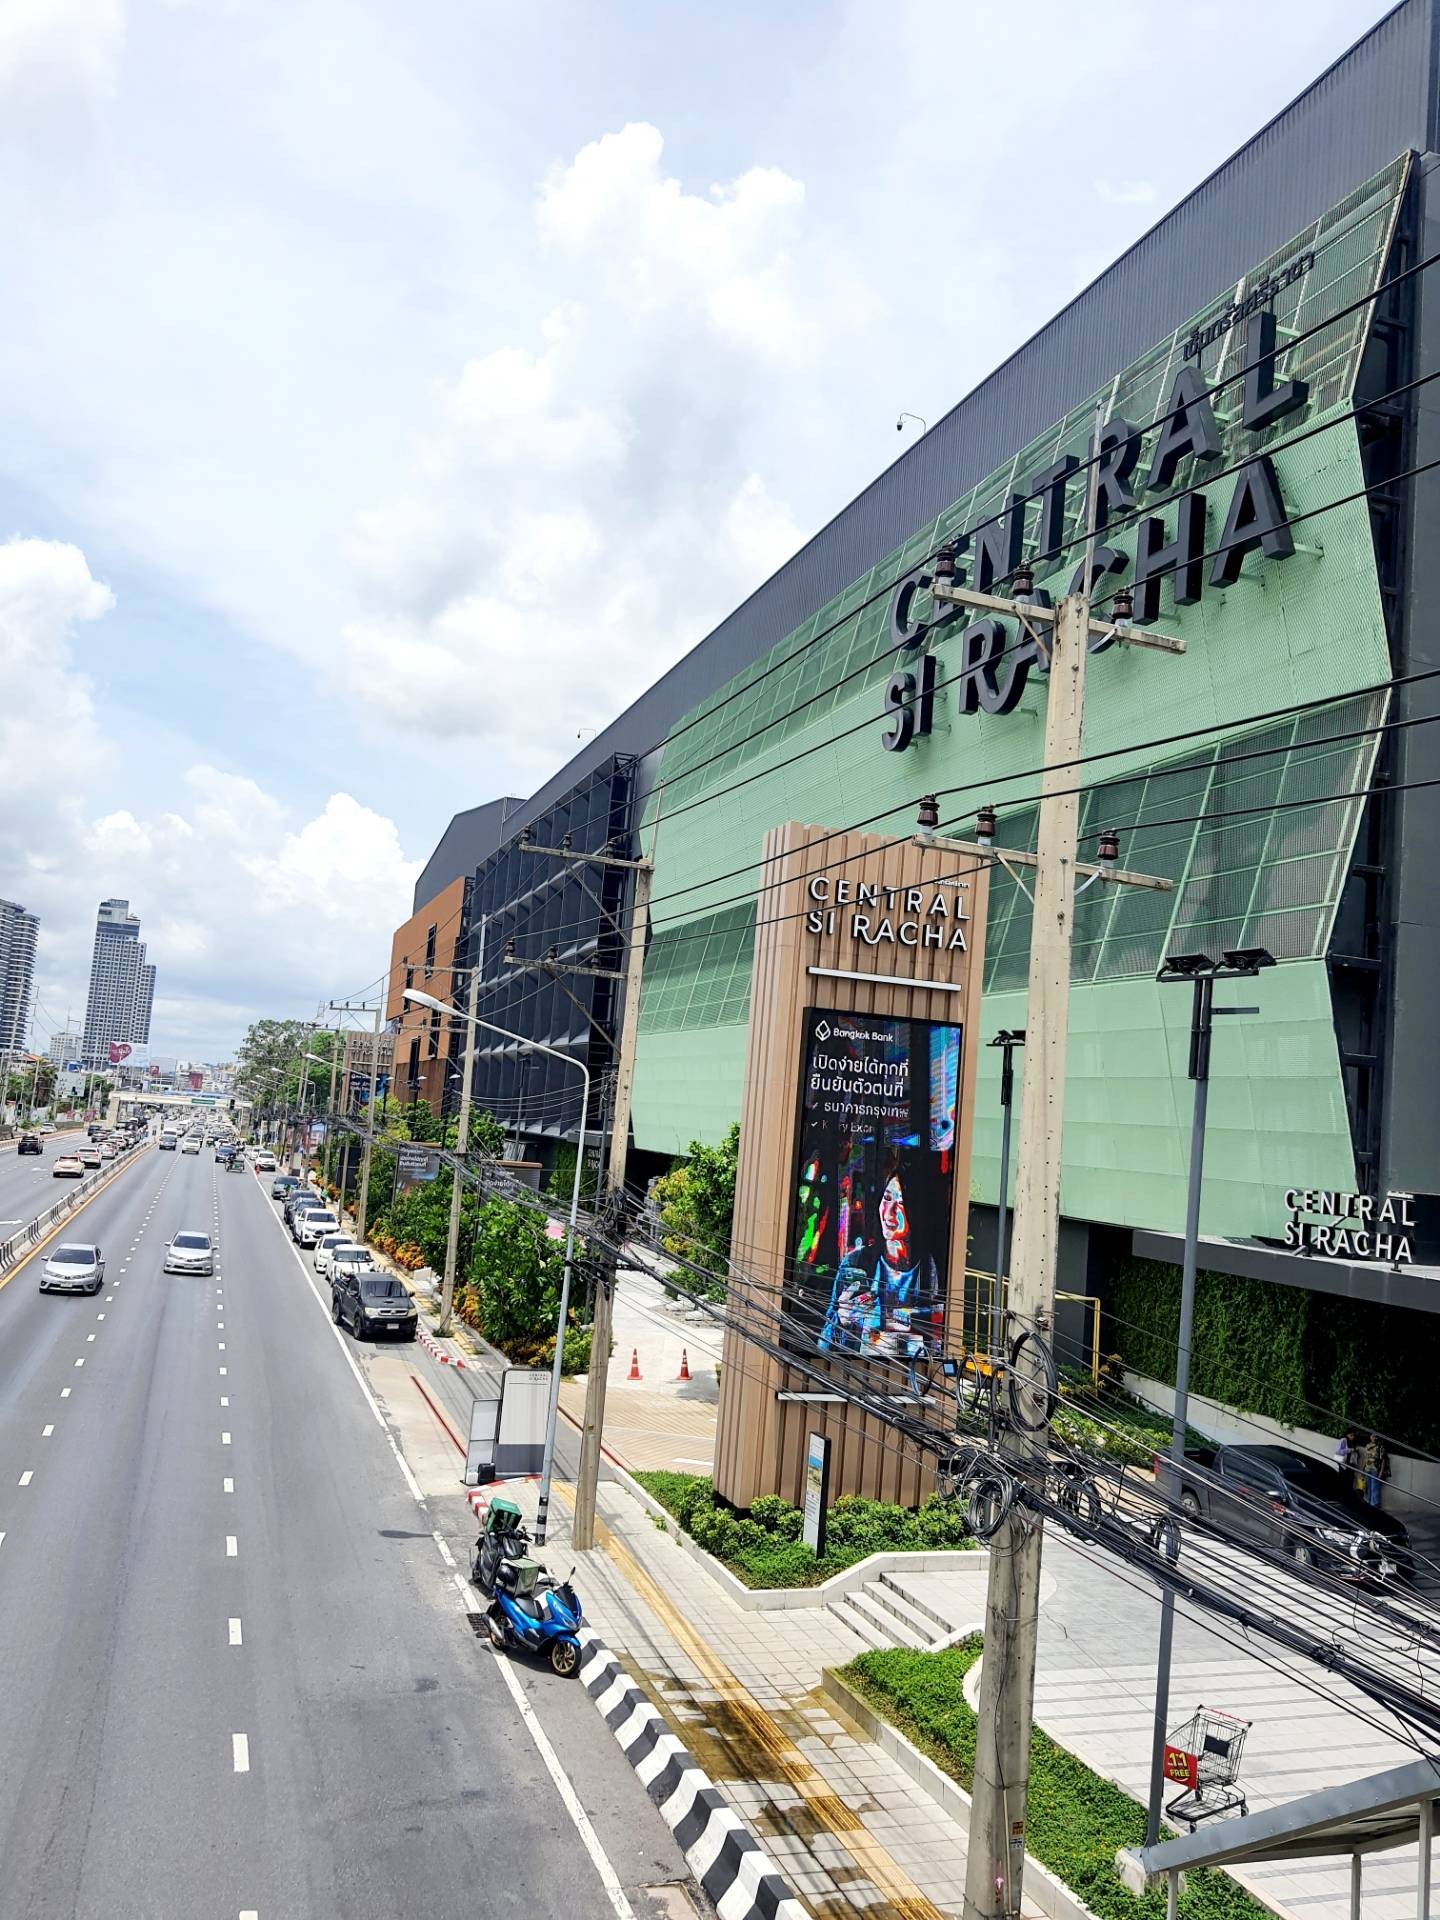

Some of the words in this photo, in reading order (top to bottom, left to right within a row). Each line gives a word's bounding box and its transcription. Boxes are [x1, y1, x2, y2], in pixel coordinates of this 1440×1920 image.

[890, 311, 1310, 650] CENTRAL
[881, 654, 936, 752] SI
[959, 453, 1296, 715] RACHA
[809, 876, 971, 920] CENTRAL
[807, 911, 835, 934] SI
[853, 915, 968, 951] RACHA
[833, 1028, 870, 1040] Bangkok
[872, 1032, 893, 1042] Bank
[811, 1073, 904, 1097] ยืนยันตัวตนที่
[813, 1054, 909, 1079] เปิดง่ายได้ทุกที่
[1284, 1189, 1416, 1226] CENTRAL
[1284, 1221, 1304, 1245] SI
[1317, 1226, 1413, 1263] RACHA
[1170, 1769, 1190, 1777] FREE
